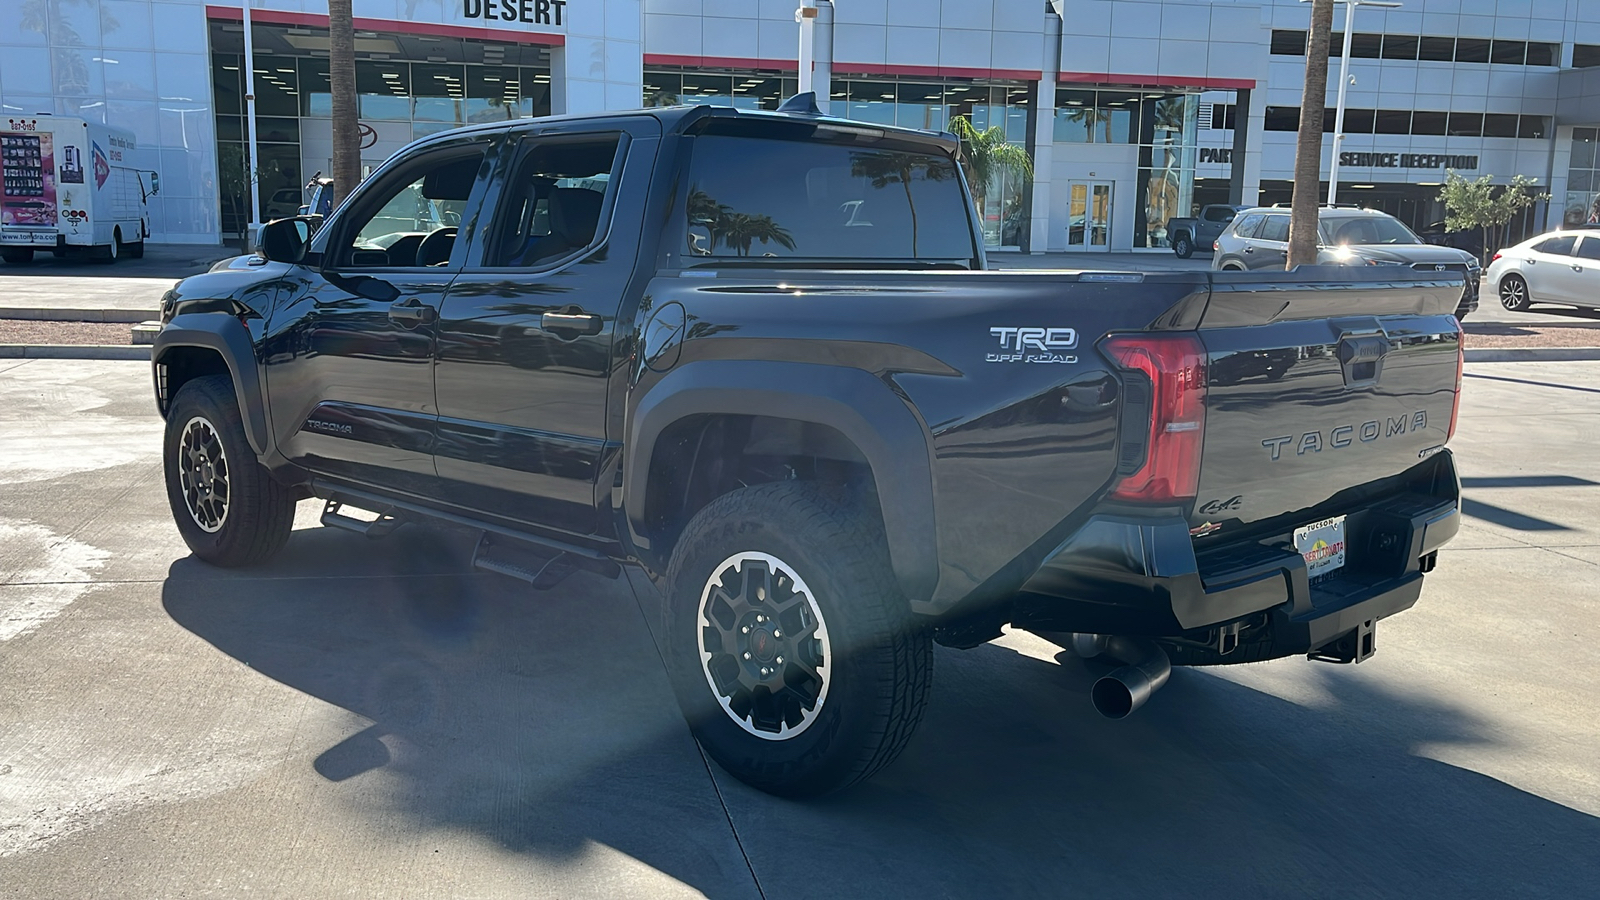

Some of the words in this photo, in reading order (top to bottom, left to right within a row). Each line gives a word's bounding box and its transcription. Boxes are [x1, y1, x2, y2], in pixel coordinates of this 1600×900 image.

[463, 0, 566, 25] DESERT
[1339, 152, 1399, 168] SERVICE
[1400, 153, 1478, 169] RECEPTION
[990, 327, 1079, 352] TRD
[985, 352, 1022, 362] OFF
[1025, 354, 1078, 363] ROAD
[307, 419, 352, 434] TACOMA
[1261, 410, 1429, 461] TACOMA
[1307, 518, 1334, 531] TUCSON
[1321, 541, 1344, 558] TOYOTA
